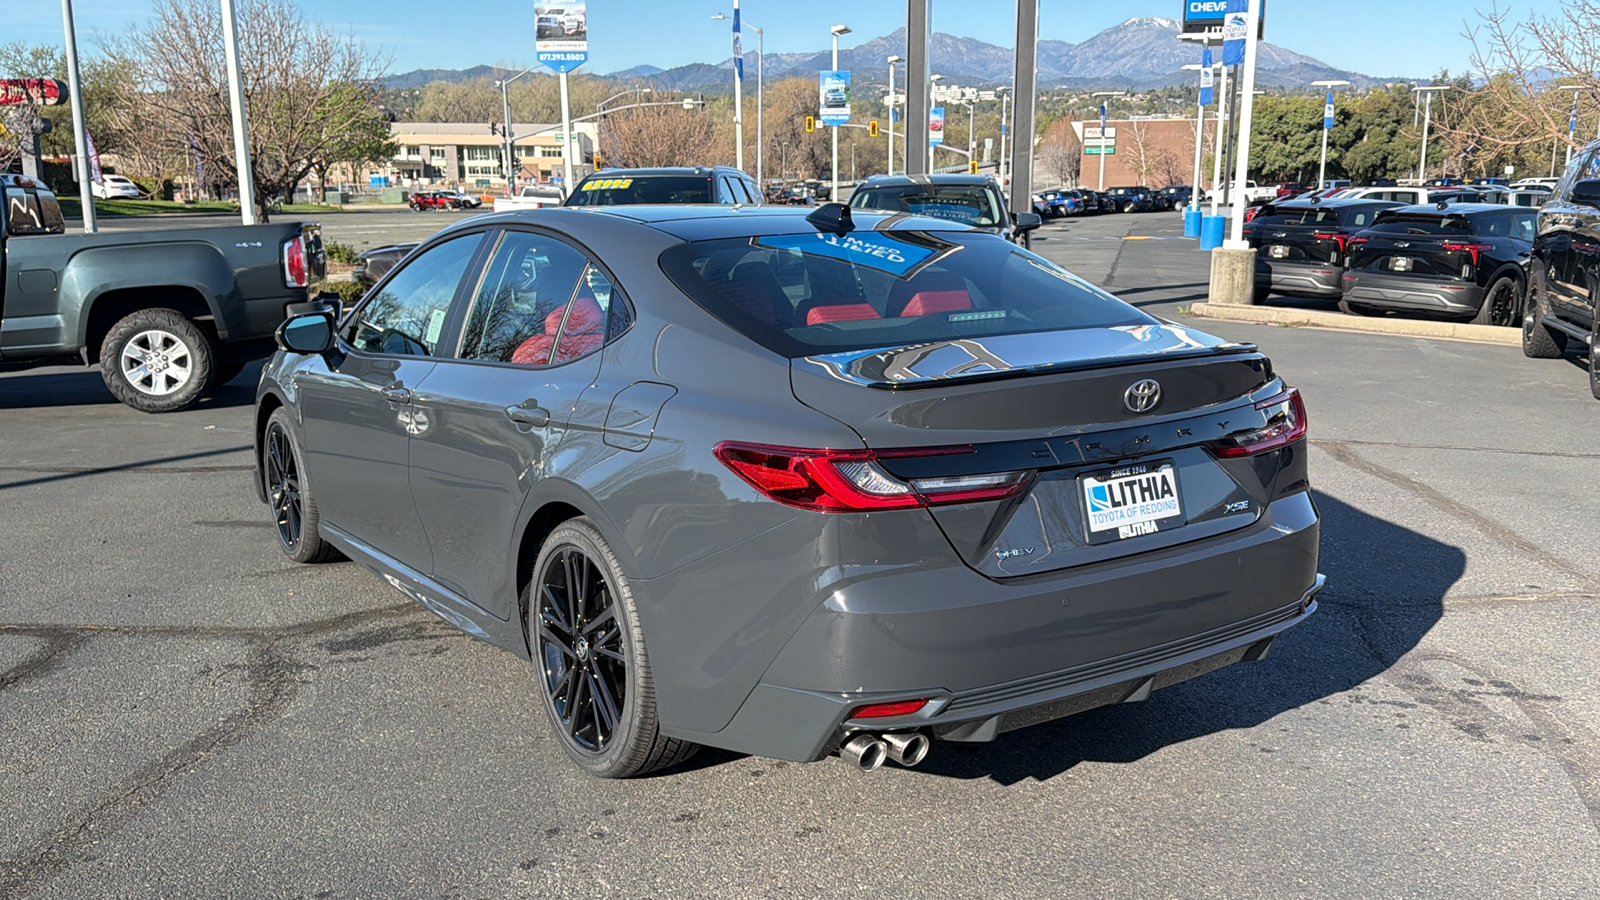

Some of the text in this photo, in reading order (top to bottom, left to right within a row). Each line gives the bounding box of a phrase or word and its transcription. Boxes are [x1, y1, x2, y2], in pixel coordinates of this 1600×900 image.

[1190, 1, 1227, 12] CHEVR
[539, 53, 585, 61] 877.293.5503
[1110, 465, 1147, 478] SINCE 1946
[1107, 474, 1174, 508] LITHIA
[1092, 499, 1177, 524] TOYOTA OF REDDING
[1223, 500, 1249, 514] XSE
[1127, 519, 1159, 537] LITHIA
